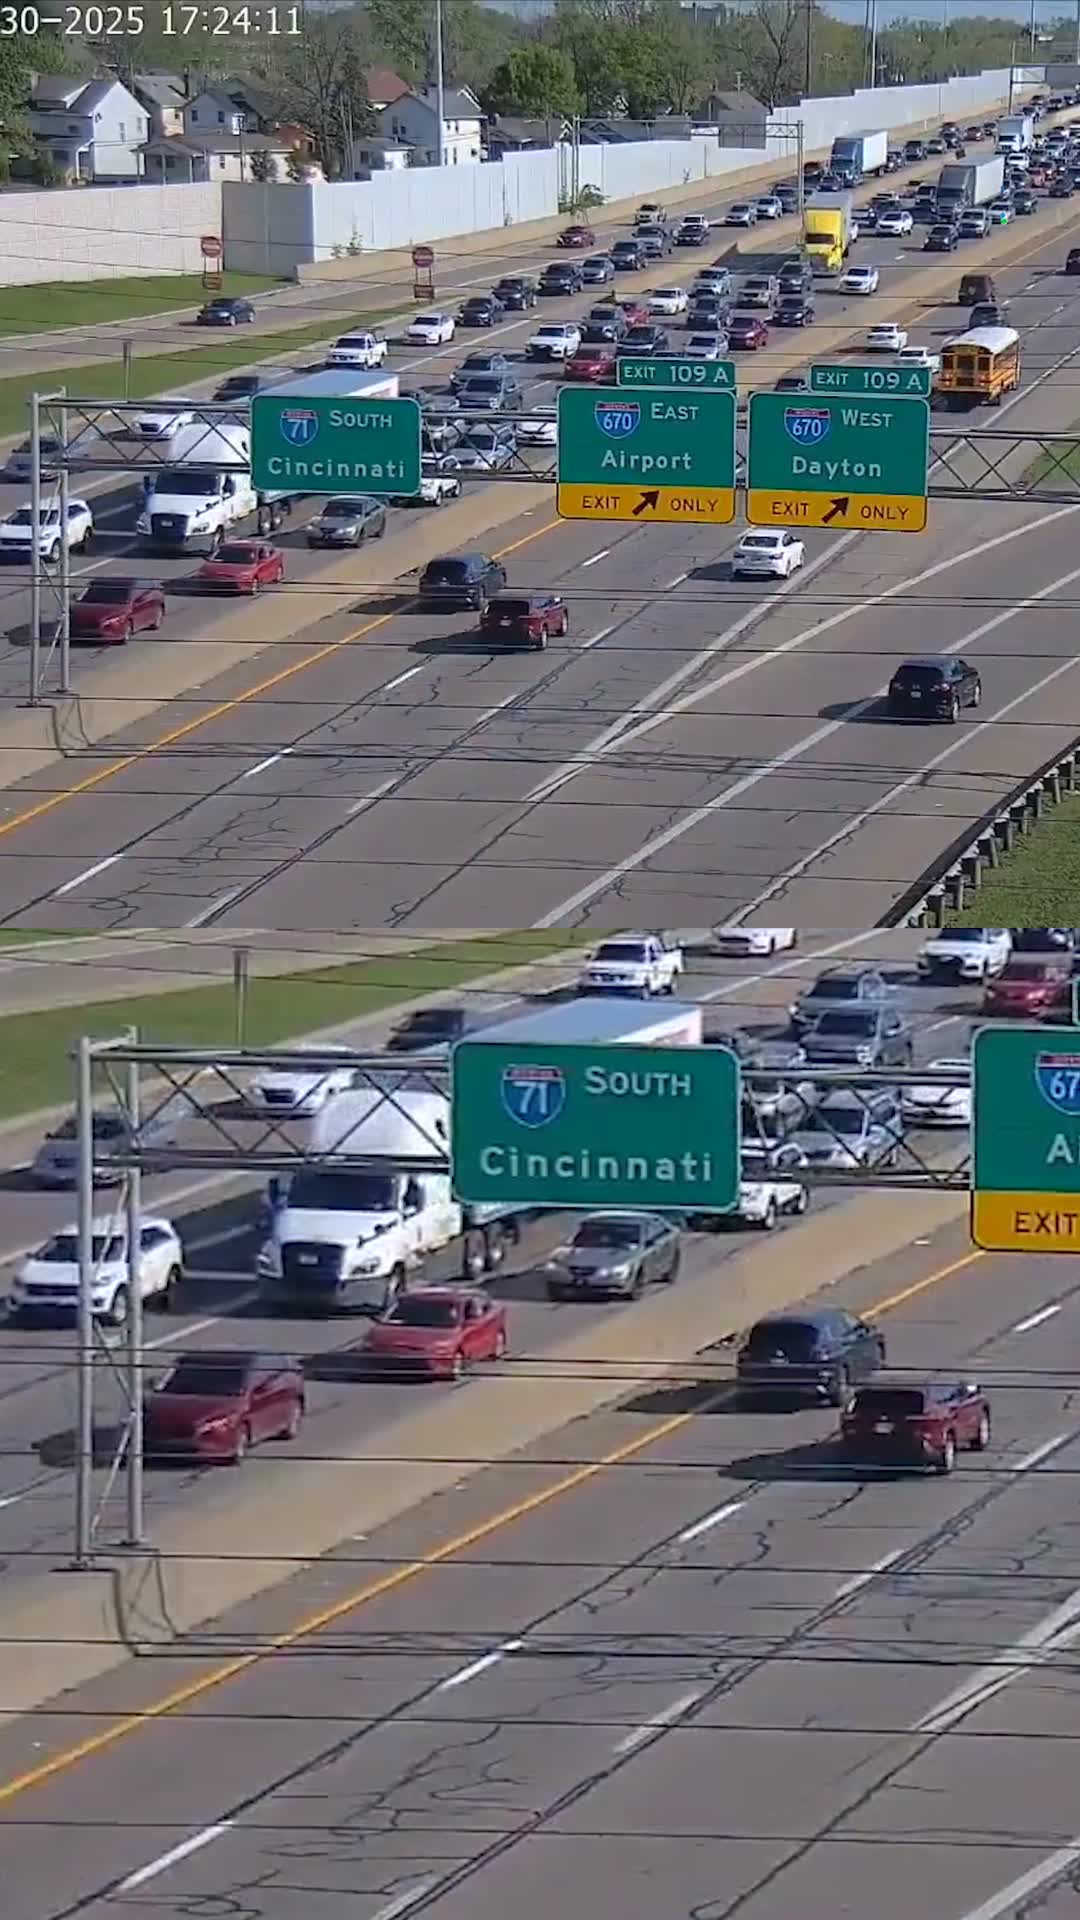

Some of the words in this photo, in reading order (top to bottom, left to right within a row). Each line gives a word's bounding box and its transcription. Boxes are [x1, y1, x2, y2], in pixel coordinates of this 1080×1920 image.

[623, 366, 656, 379] EXIT
[670, 366, 707, 383] 109
[713, 367, 729, 384] A
[816, 372, 849, 386] EXIT
[864, 372, 901, 389] 109
[906, 373, 923, 390] A
[287, 418, 309, 439] 71
[329, 410, 392, 428] SOUTH
[603, 413, 633, 430] 670
[651, 403, 699, 420] EAST
[792, 418, 822, 437] 670
[841, 409, 893, 428] WEST
[267, 457, 405, 479] Cincinnati
[601, 449, 692, 472] Airport
[792, 456, 881, 480] Dayton
[583, 495, 620, 509] EXIT
[670, 497, 718, 512] ONLY
[772, 502, 810, 516] EXIT
[860, 505, 909, 520] ONLY
[515, 1081, 549, 1115] 71
[584, 1066, 692, 1097] SOUTH
[480, 1146, 712, 1182] Cincinnati
[1014, 1212, 1079, 1235] EXIT
